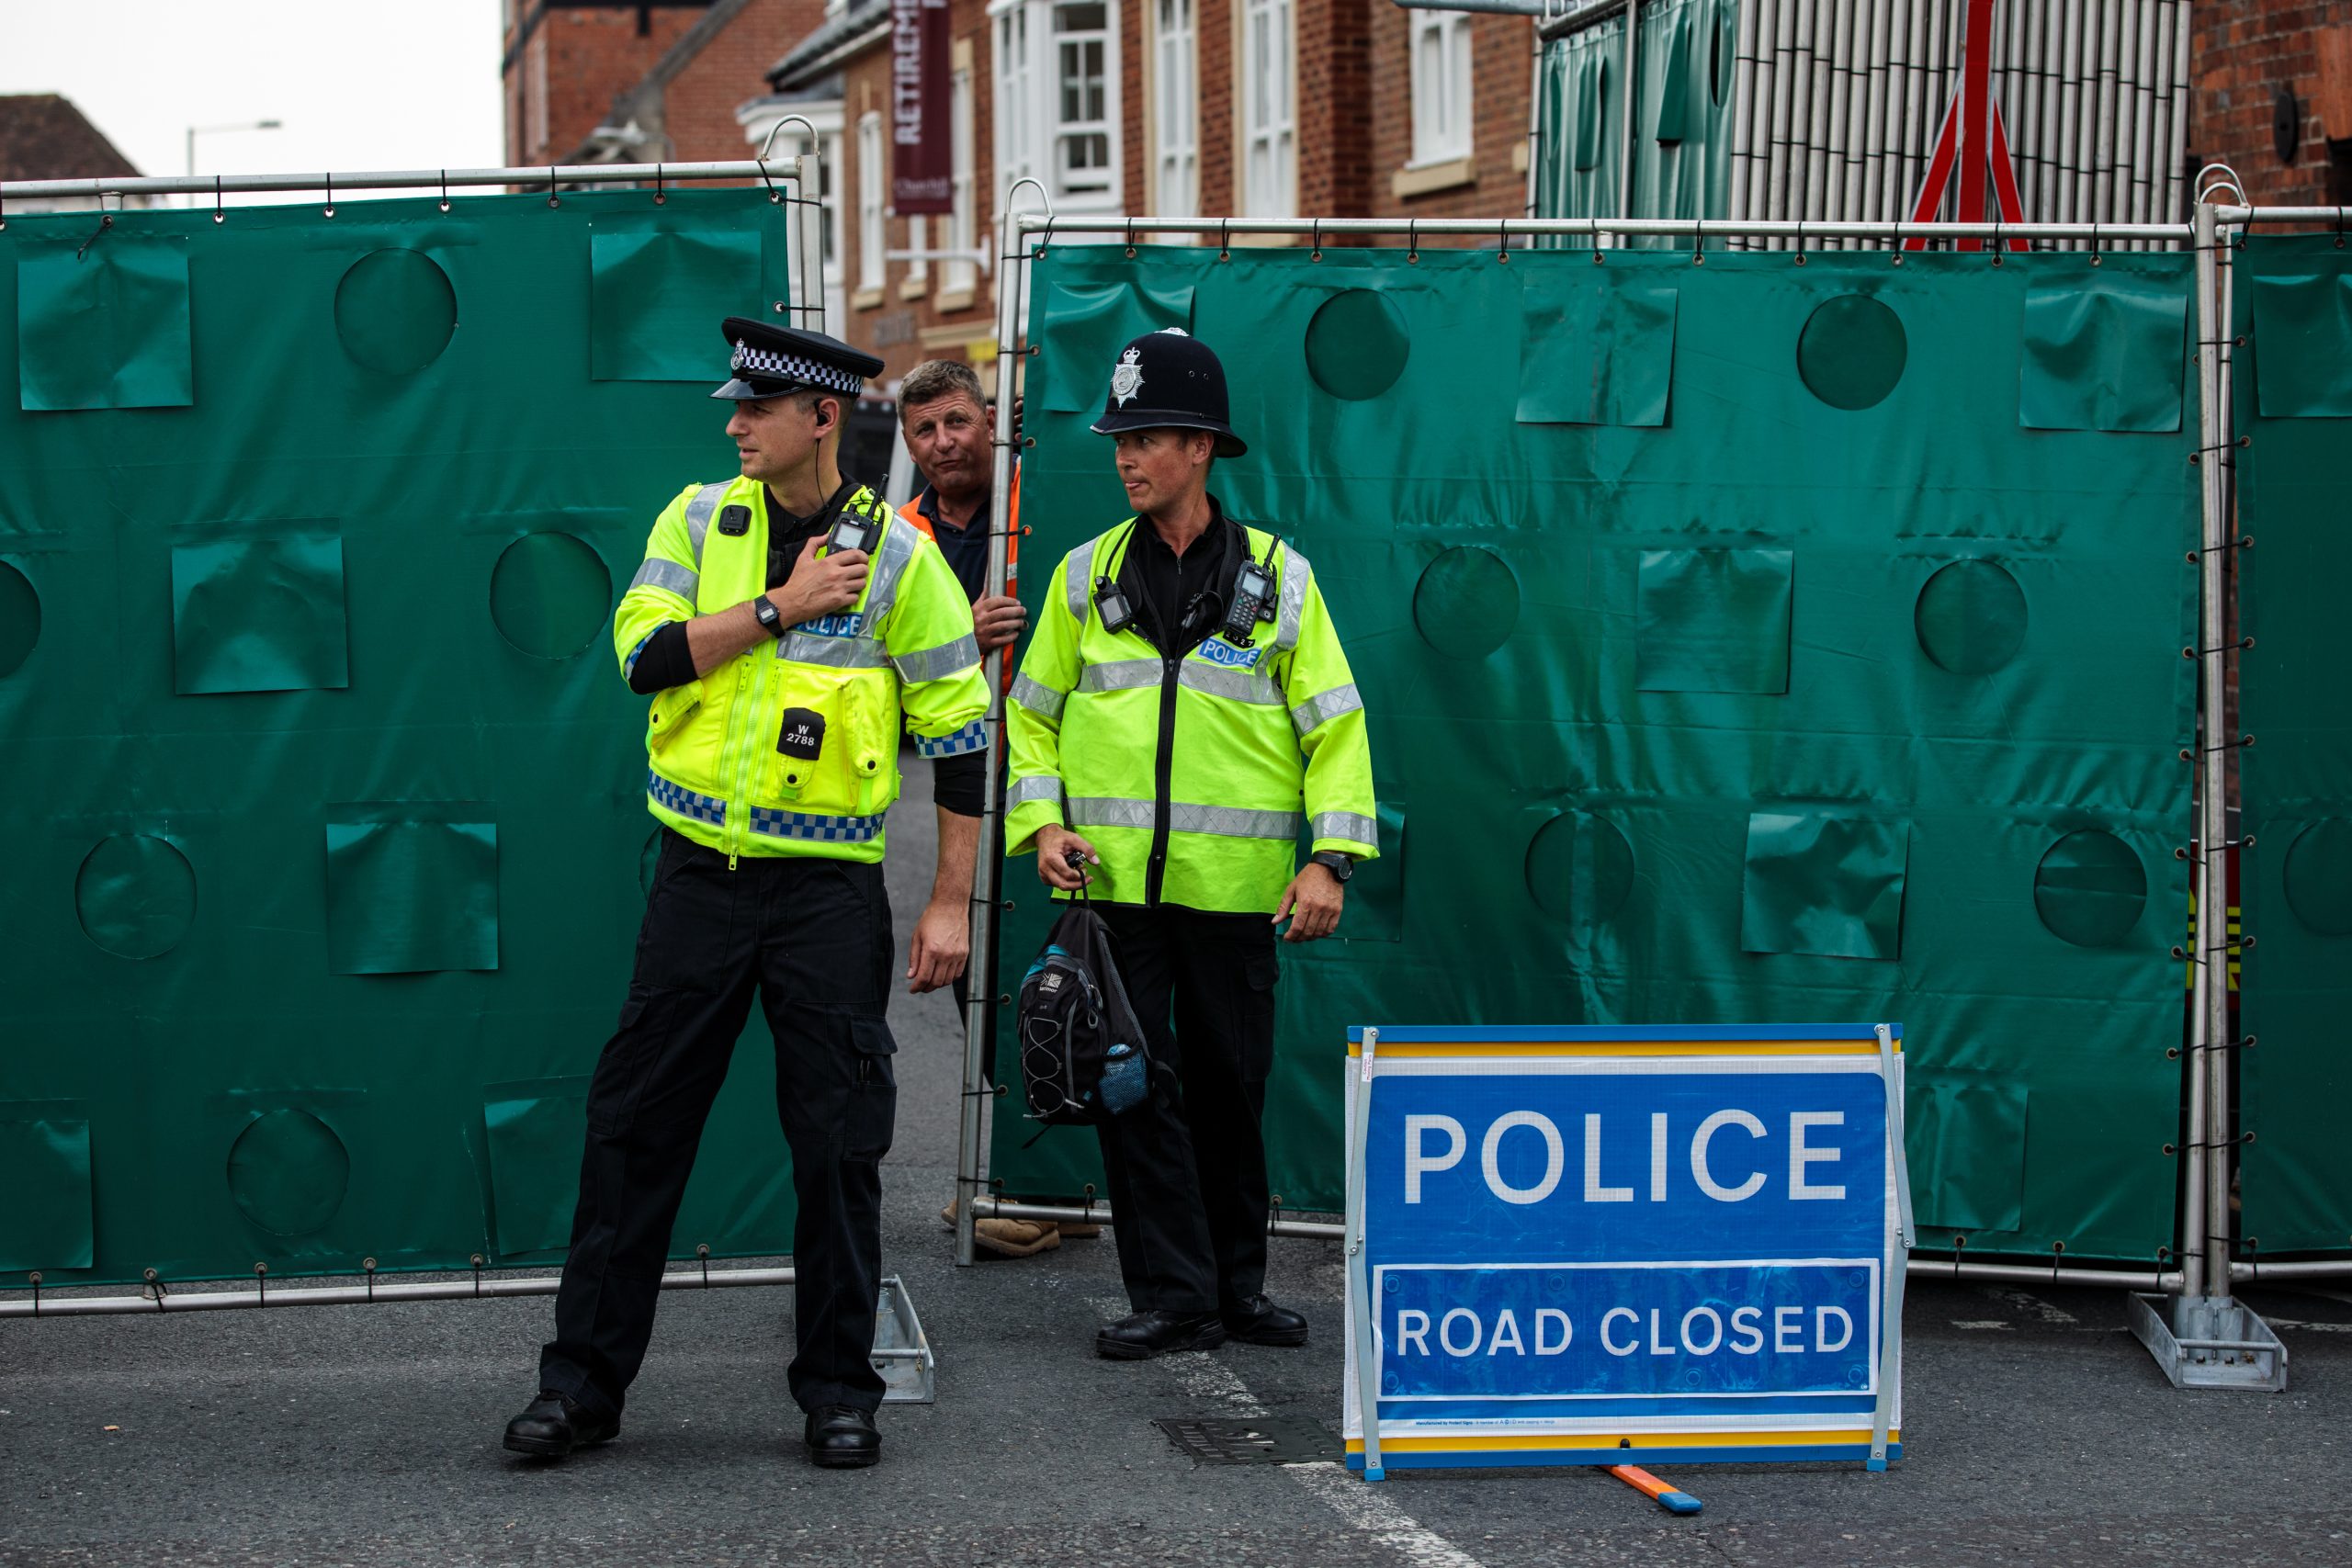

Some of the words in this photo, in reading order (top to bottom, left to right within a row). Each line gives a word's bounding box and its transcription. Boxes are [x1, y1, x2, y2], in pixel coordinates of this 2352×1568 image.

[797, 615, 861, 635] OLICE
[1204, 640, 1258, 664] POLICE
[786, 732, 815, 746] 2788
[797, 724, 809, 735] W
[1404, 1109, 1847, 1205] POLICE
[1396, 1307, 1574, 1358] ROAD
[1599, 1305, 1854, 1357] CLOSED
